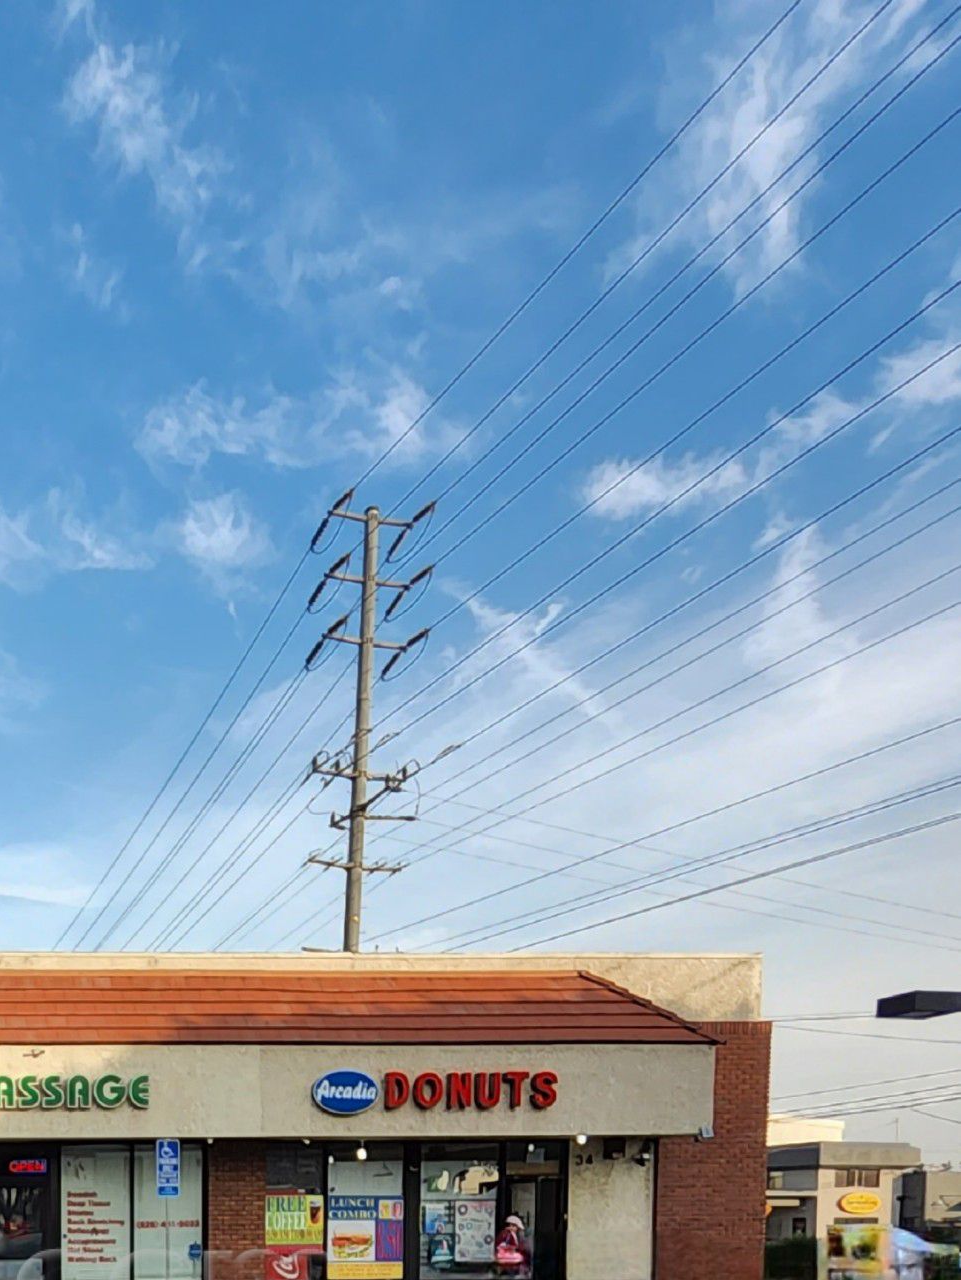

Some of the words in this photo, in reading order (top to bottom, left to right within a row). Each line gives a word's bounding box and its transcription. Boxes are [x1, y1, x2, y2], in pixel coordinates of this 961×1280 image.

[317, 1079, 377, 1102] Arcadia
[384, 1071, 558, 1109] DONUTS
[9, 1159, 46, 1173] OPEN
[267, 1196, 307, 1212] FREE
[330, 1197, 375, 1208] LUNCH
[266, 1212, 306, 1230] COFFEE
[328, 1209, 377, 1219] COMBO
